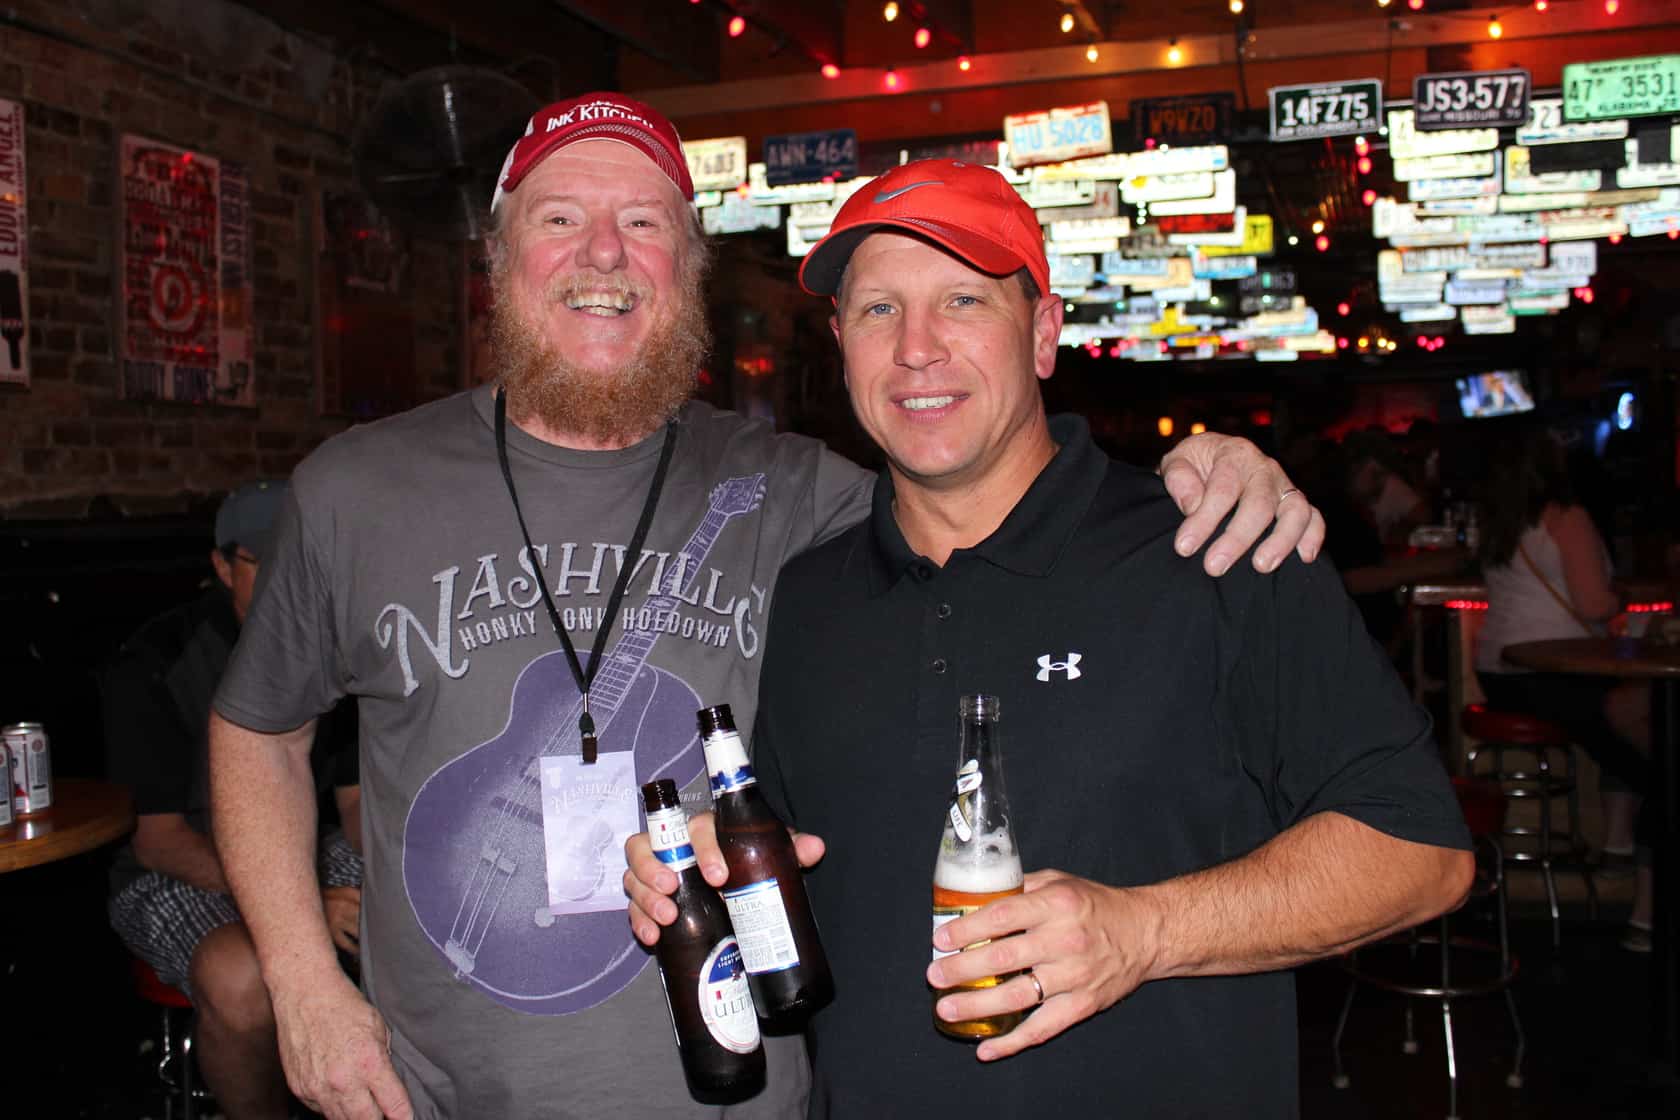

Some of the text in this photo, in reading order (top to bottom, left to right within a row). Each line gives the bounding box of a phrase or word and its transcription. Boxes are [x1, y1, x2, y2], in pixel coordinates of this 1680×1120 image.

[1420, 75, 1525, 112] JS3-577
[1623, 72, 1675, 98] 3531
[546, 111, 575, 132] INK
[1281, 92, 1369, 126] 14FZ75
[1444, 108, 1500, 121] MISSOURI
[768, 137, 854, 167] AWN-464
[0, 192, 16, 257] EDDI
[458, 606, 731, 652] HONKY ONK HOEDOWN
[660, 831, 688, 846] ULT
